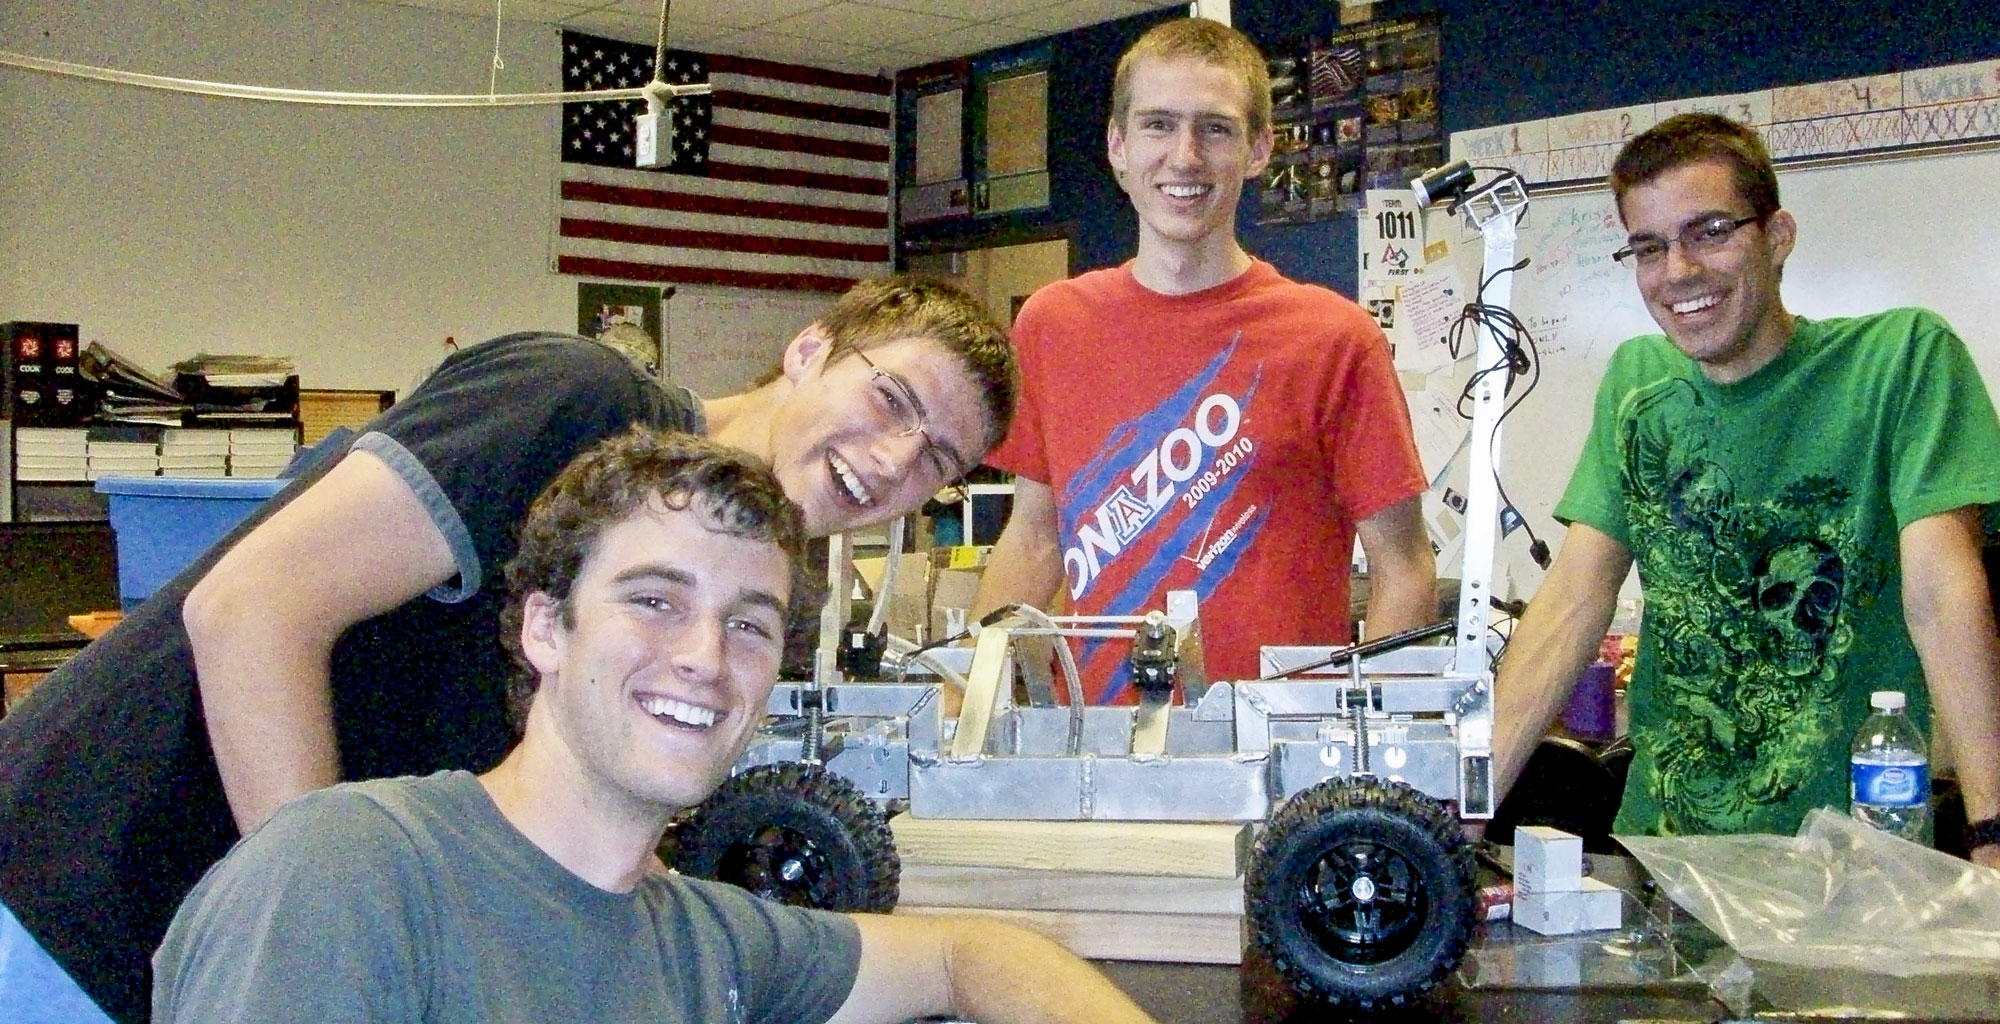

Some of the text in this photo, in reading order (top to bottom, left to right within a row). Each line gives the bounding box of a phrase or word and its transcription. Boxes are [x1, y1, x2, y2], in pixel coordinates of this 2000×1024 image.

[1852, 84, 1872, 109] 4
[1620, 112, 1633, 138] 2
[1739, 103, 1753, 123] 3
[1511, 126, 1522, 153] 1
[1375, 211, 1415, 240] 1011
[1182, 437, 1254, 509] 2009-2010
[1197, 527, 1237, 571] verizon
